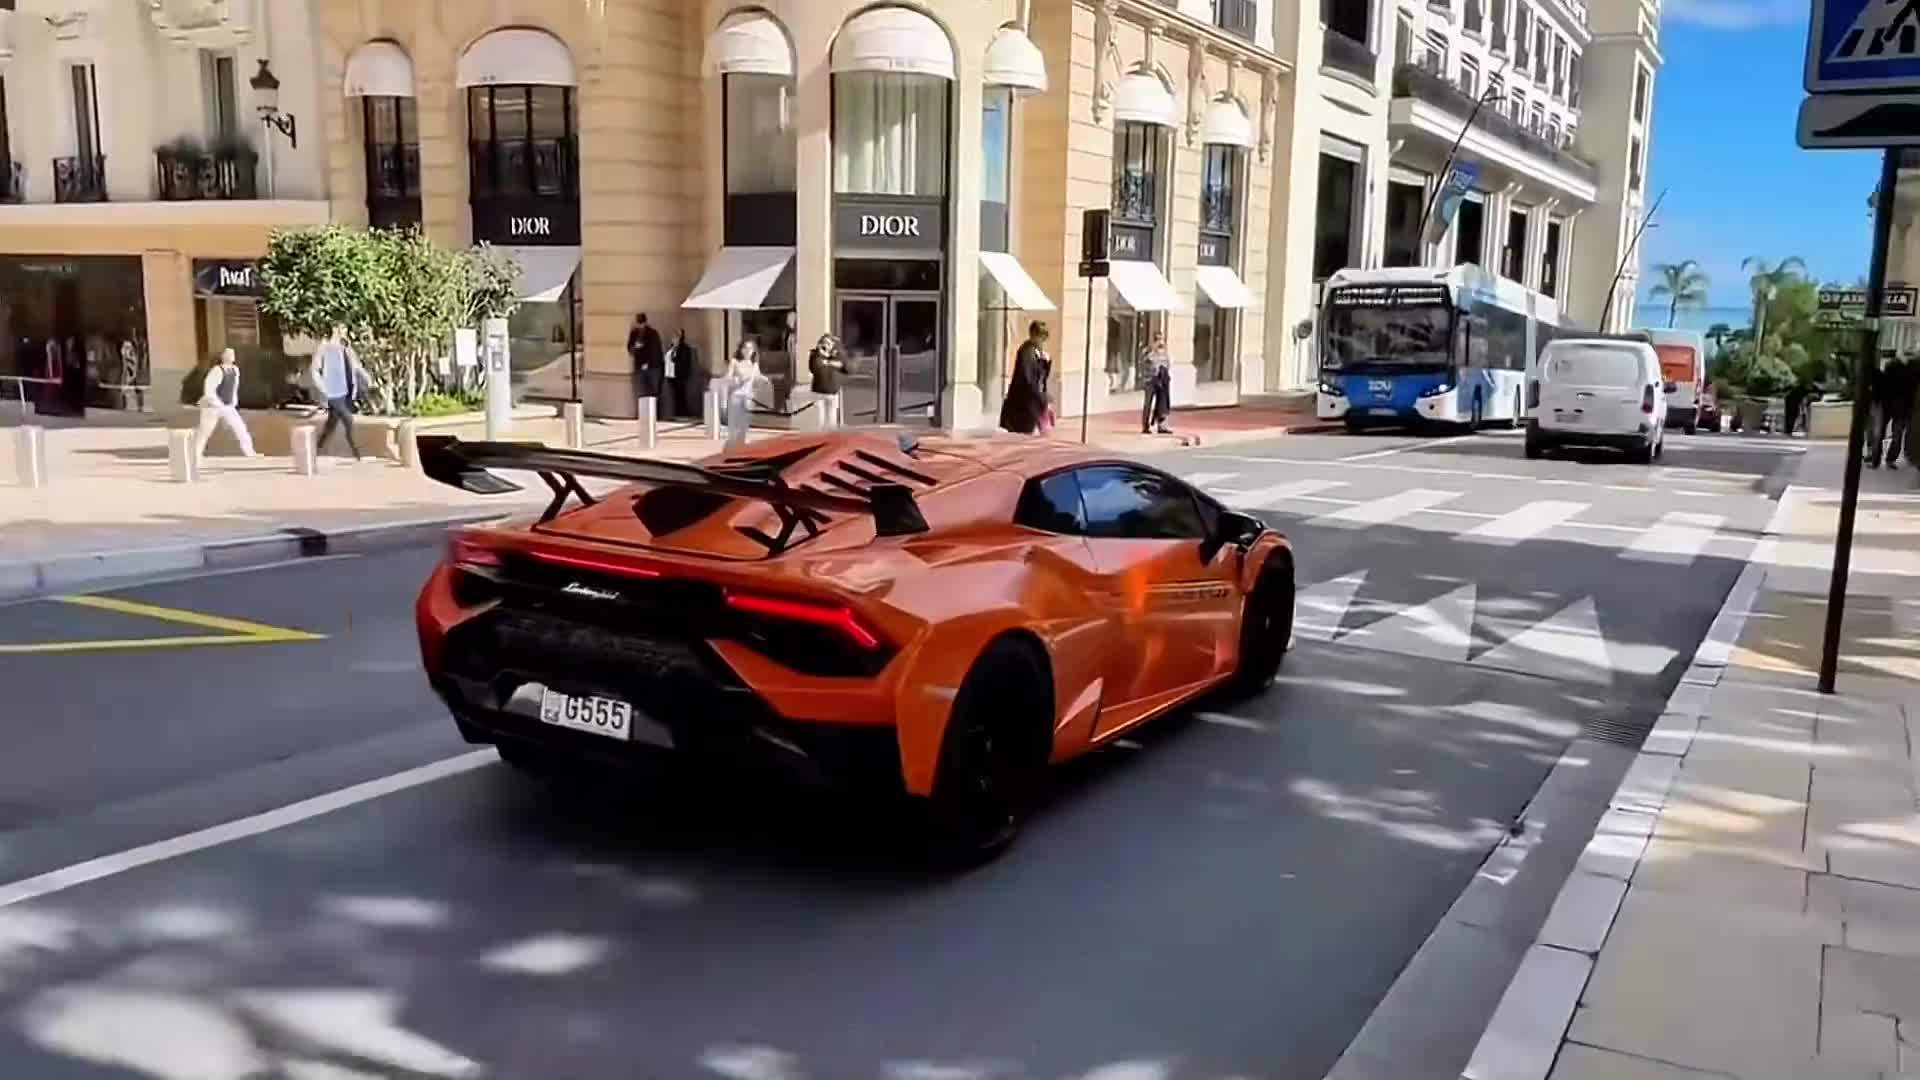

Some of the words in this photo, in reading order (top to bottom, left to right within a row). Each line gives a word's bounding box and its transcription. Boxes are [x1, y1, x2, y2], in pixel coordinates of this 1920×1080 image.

[511, 216, 550, 236] DIOR
[861, 215, 920, 236] DIOR
[565, 697, 625, 730] G555
